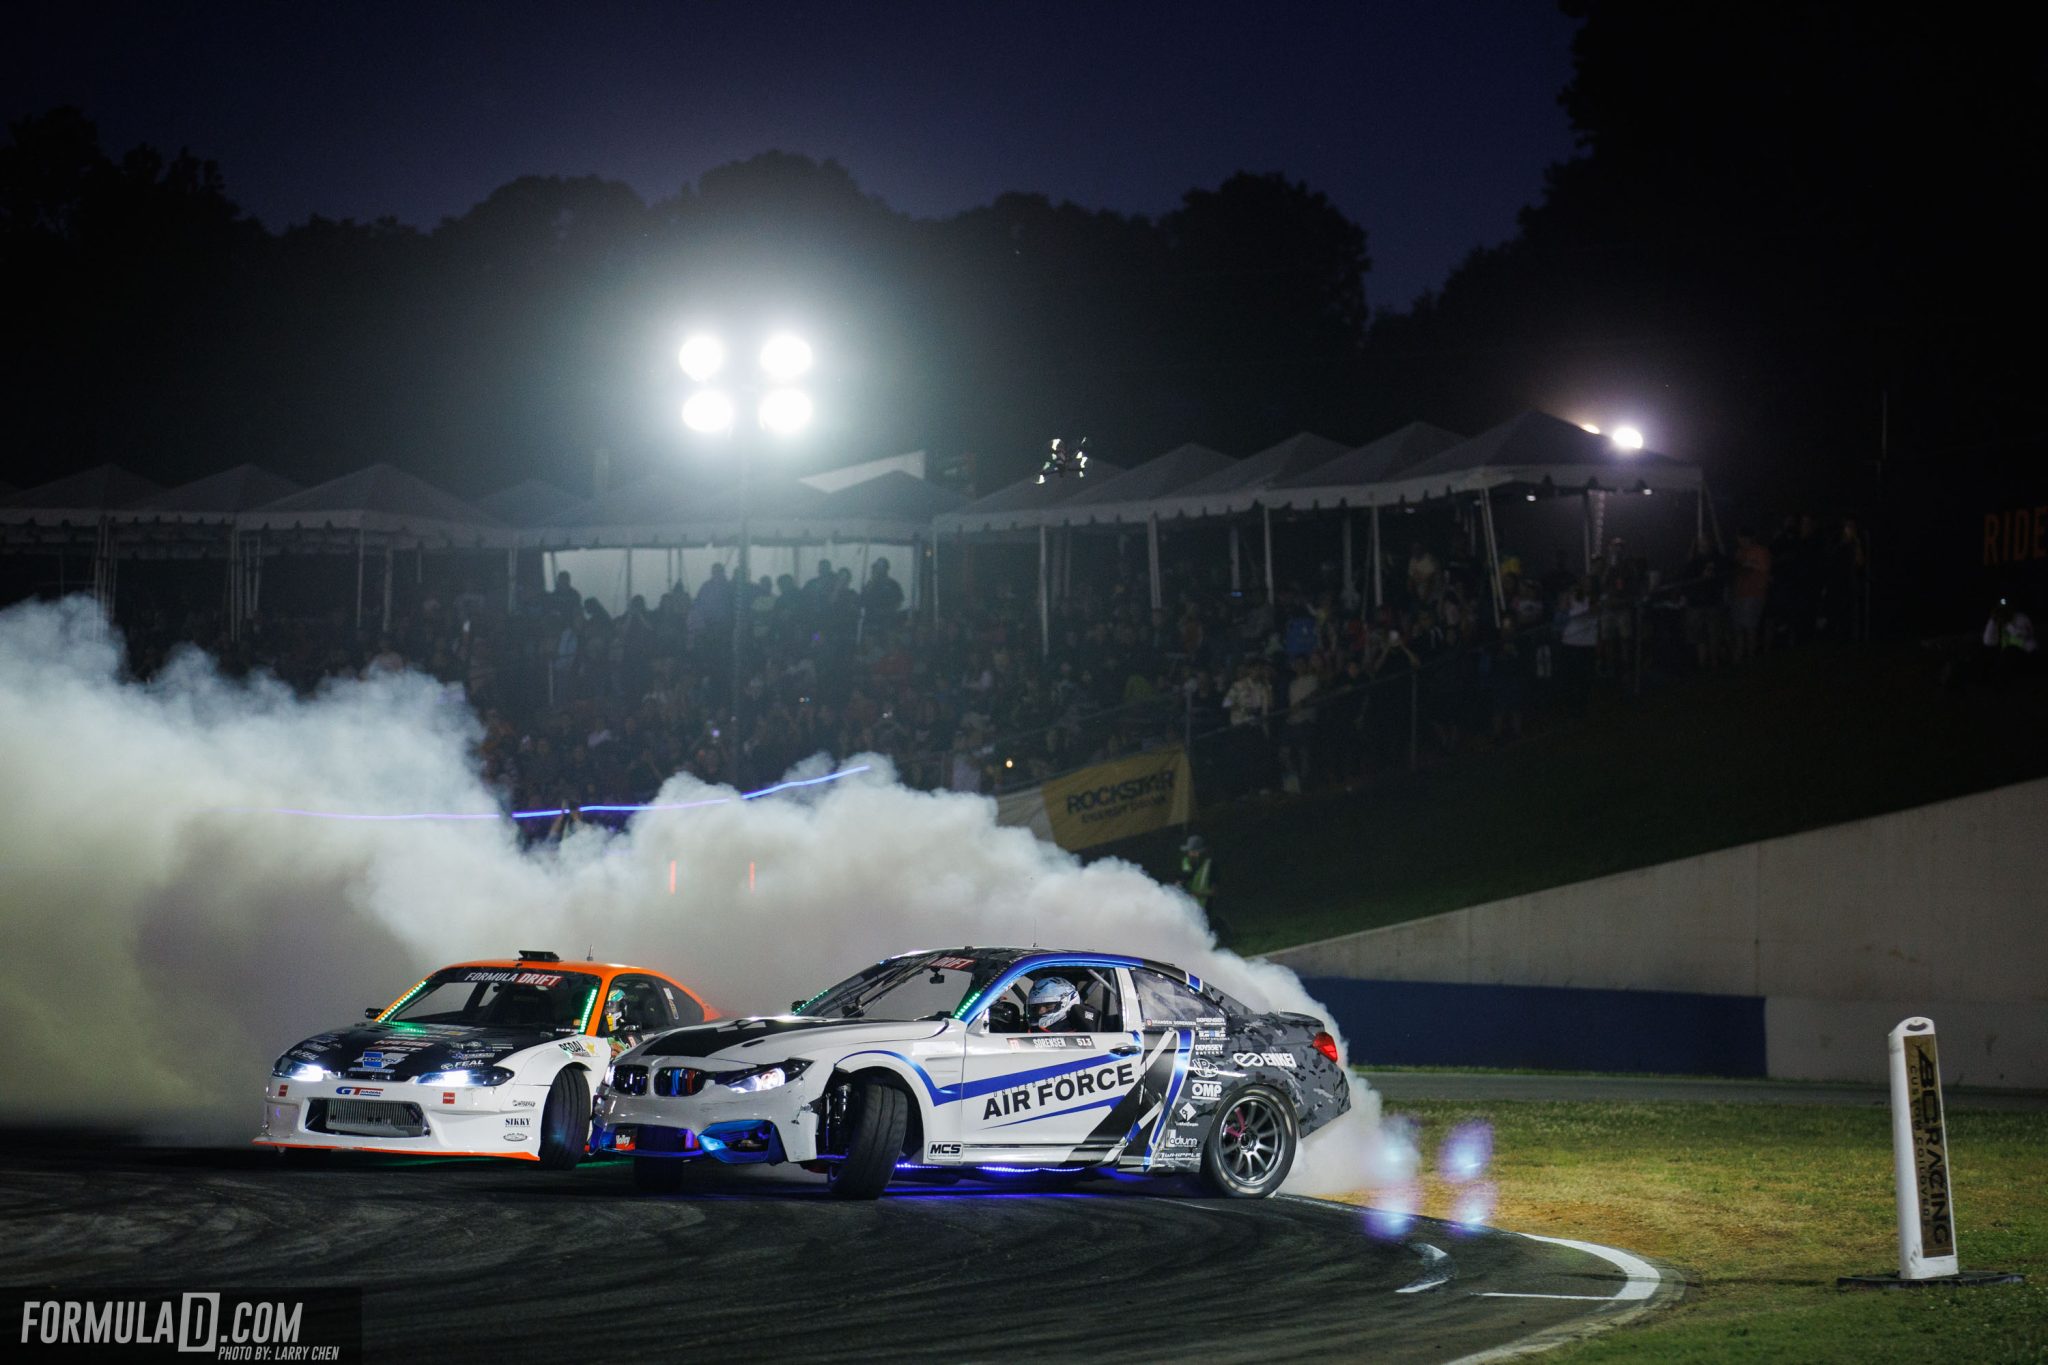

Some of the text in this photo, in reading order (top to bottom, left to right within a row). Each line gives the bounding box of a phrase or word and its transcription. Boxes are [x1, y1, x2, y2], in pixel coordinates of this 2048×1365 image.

[464, 972, 562, 986] FORMULA DRIFT
[1033, 1038, 1067, 1048] SORENSEN
[1076, 1038, 1092, 1047] 513
[454, 1060, 484, 1068] FEAL
[1261, 1053, 1297, 1068] ENKEI
[336, 1086, 375, 1096] GT
[983, 1063, 1135, 1120] AIR FORCE
[1192, 1083, 1222, 1098] OMP
[505, 1118, 531, 1126] SIKKY
[930, 1144, 962, 1154] MCS
